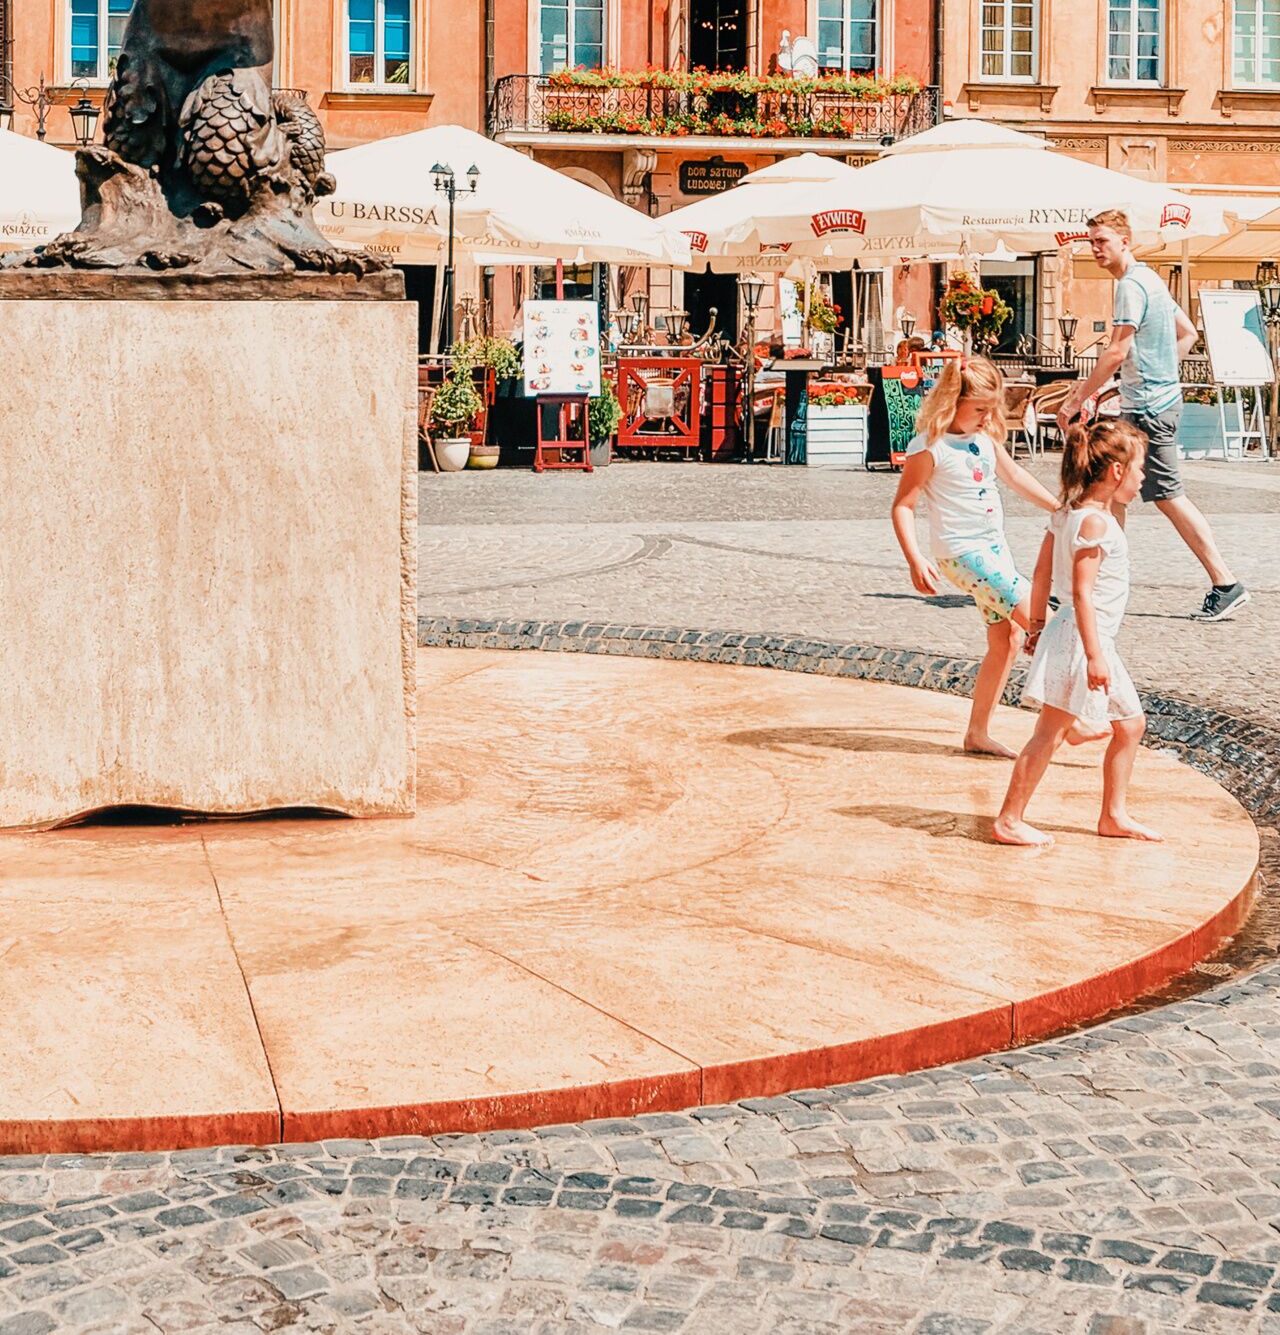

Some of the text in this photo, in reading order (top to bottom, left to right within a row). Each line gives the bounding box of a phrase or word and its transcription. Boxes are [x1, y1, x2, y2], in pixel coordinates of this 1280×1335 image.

[331, 202, 440, 226] U BARSSA
[816, 211, 859, 229] ŻYWIEC
[962, 208, 1093, 227] Restauracja RYNEK
[2, 224, 48, 237] KSIĄŻĘCE
